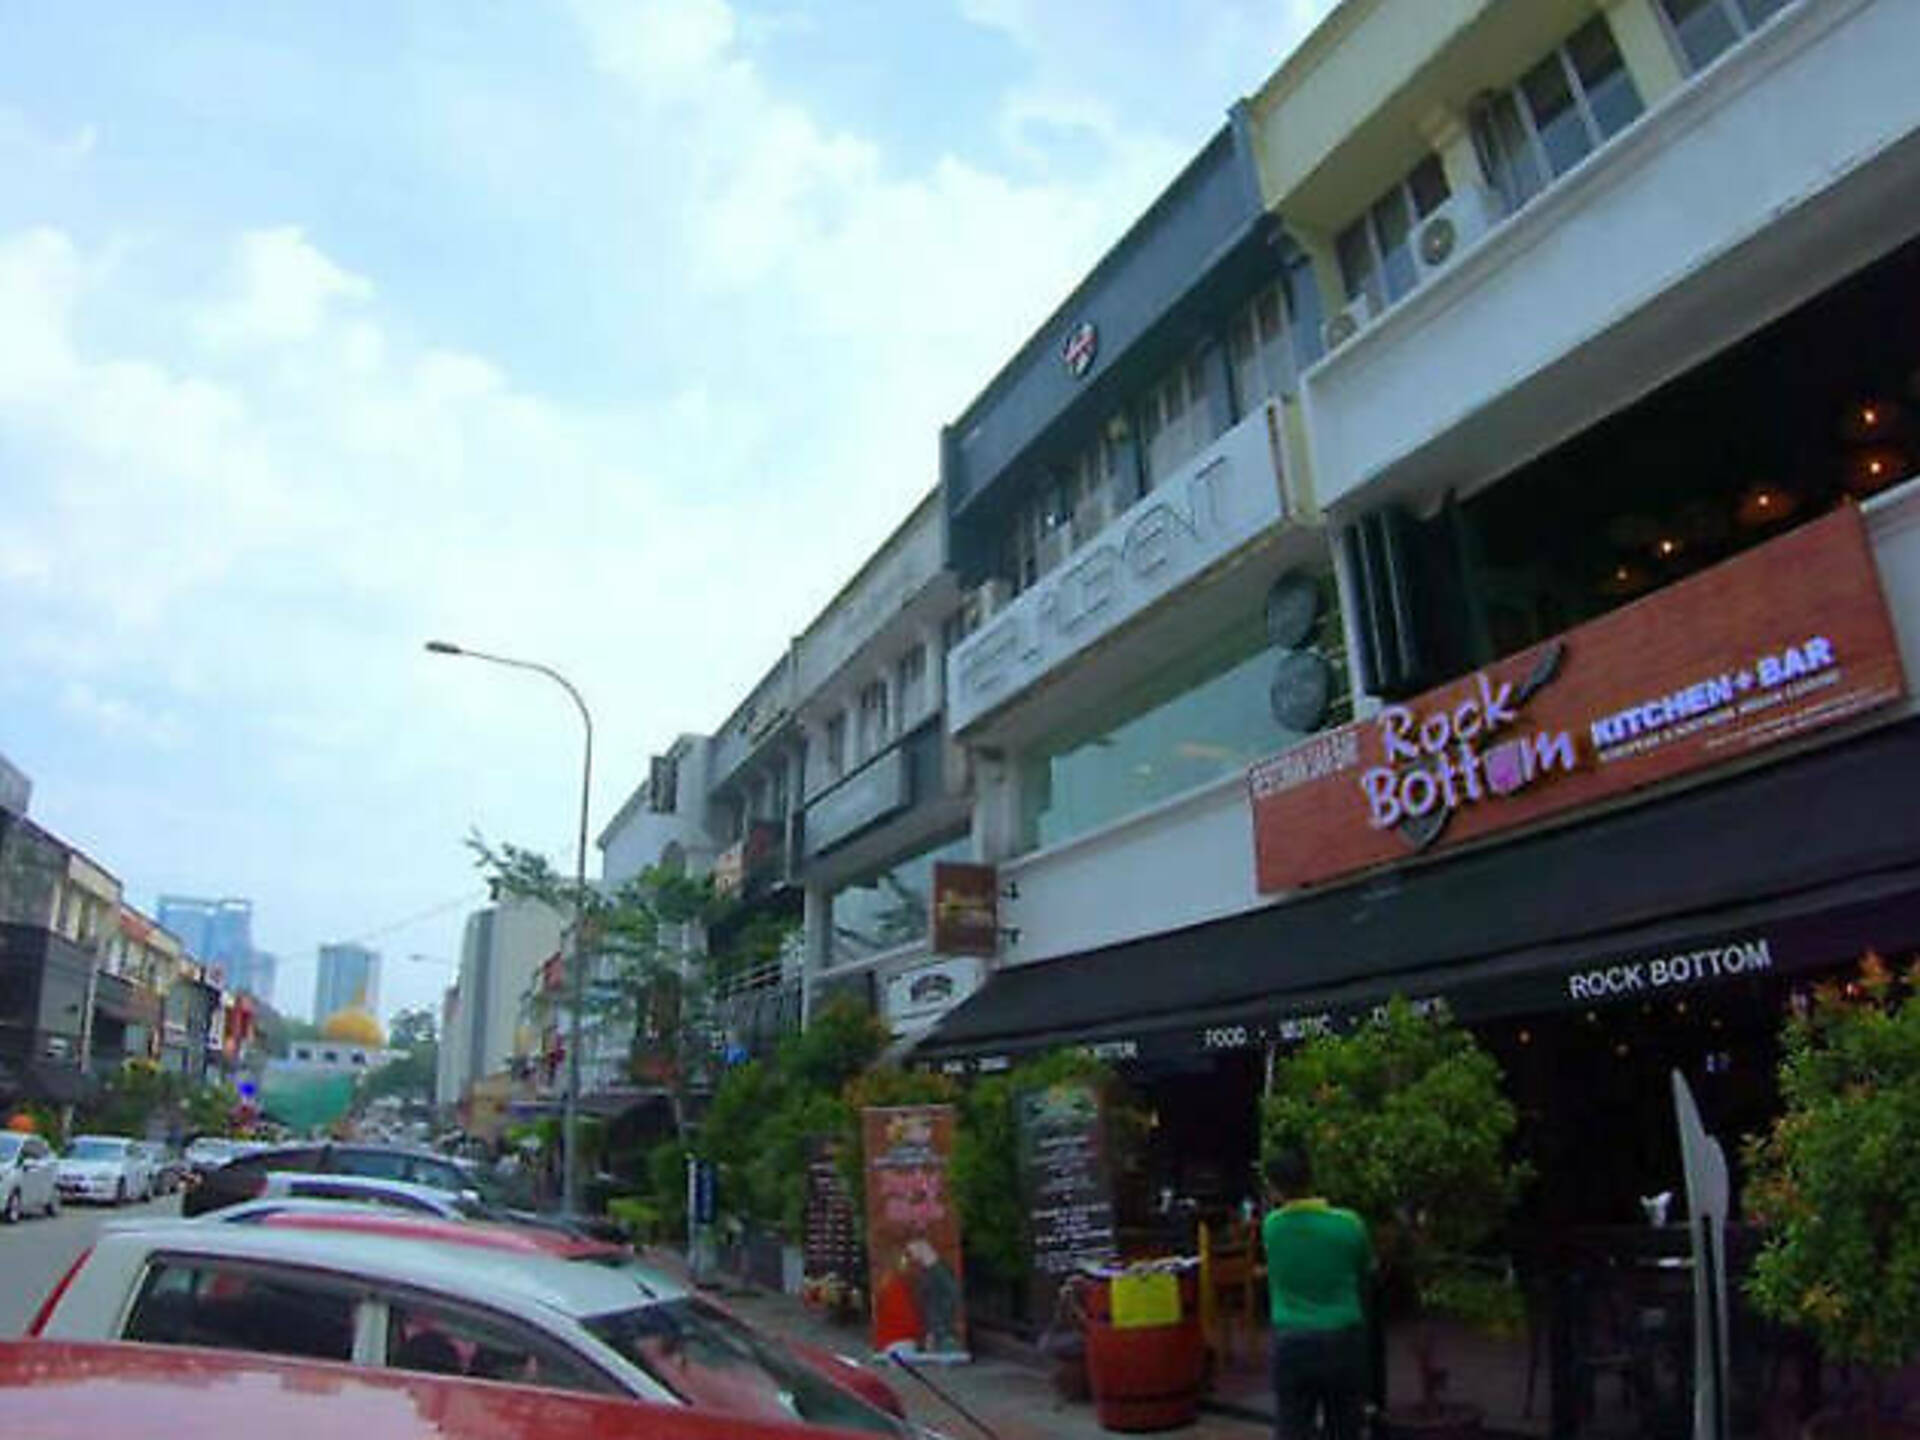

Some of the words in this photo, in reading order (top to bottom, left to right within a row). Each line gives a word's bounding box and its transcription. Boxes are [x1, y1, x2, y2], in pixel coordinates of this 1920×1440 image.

[1379, 670, 1517, 763] Rock
[1591, 674, 1734, 746] KITCHEN
[1758, 635, 1834, 685] BAR
[1569, 963, 1644, 998] ROCK
[1650, 939, 1772, 986] BOTTOM
